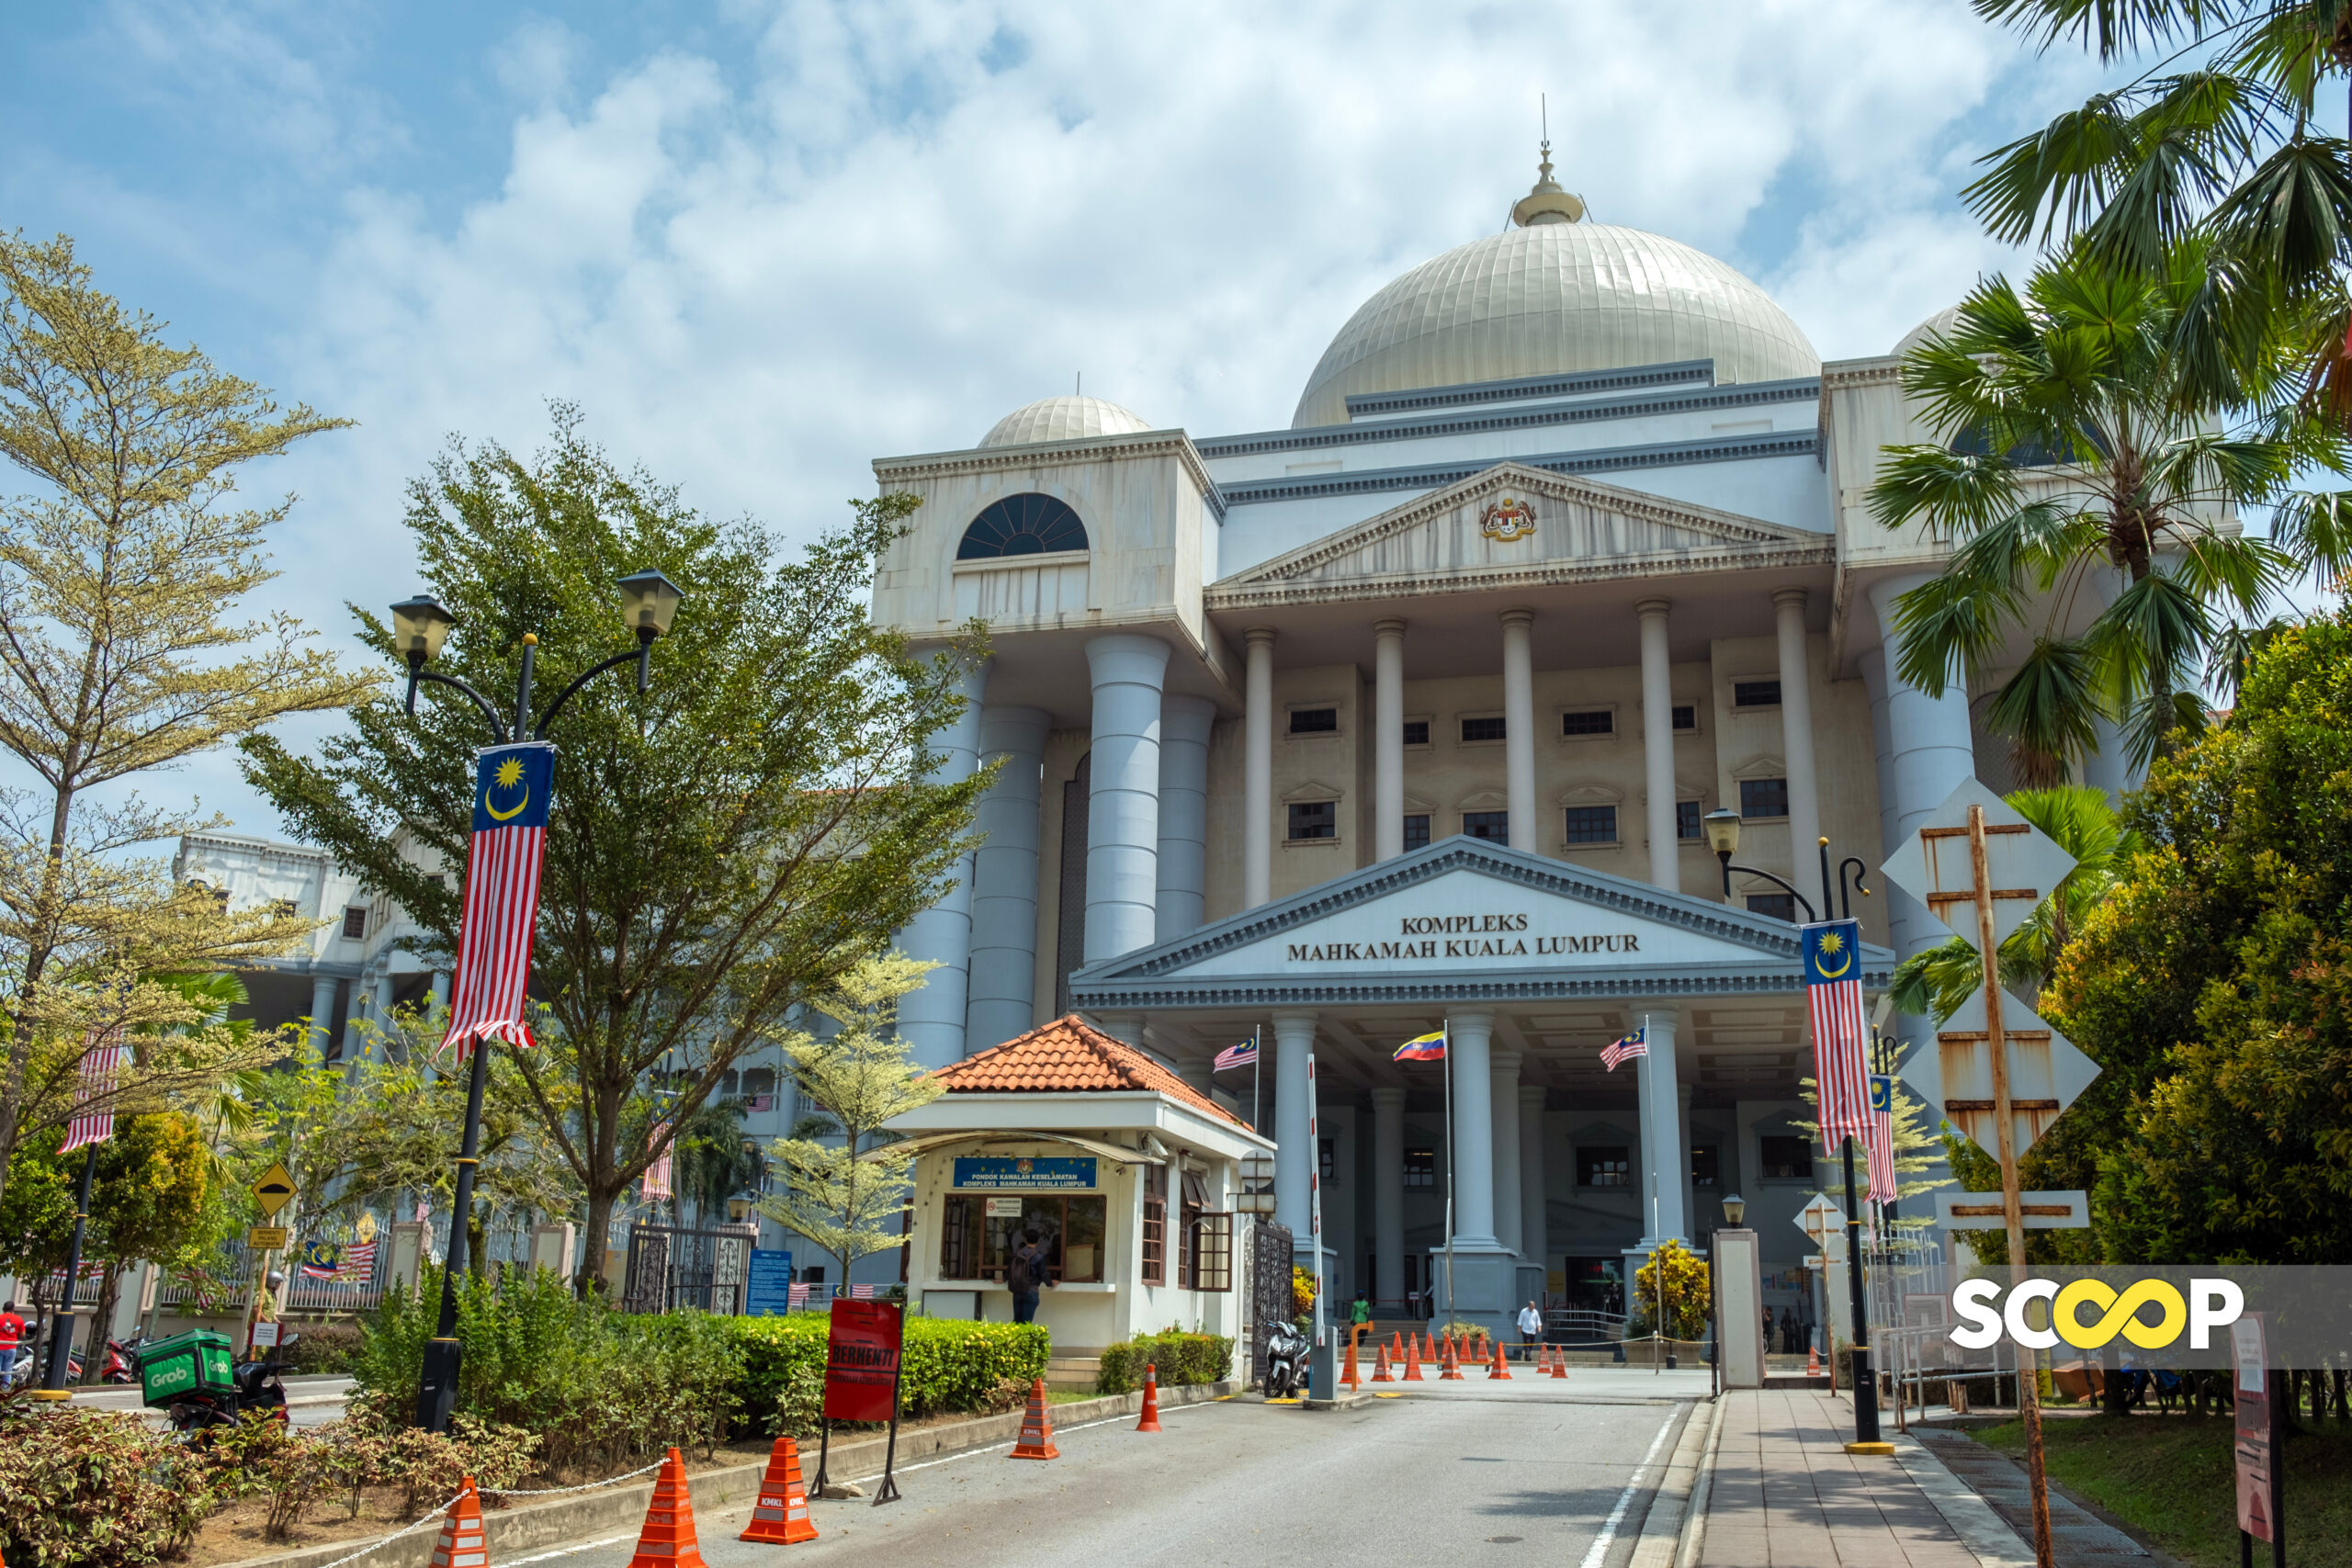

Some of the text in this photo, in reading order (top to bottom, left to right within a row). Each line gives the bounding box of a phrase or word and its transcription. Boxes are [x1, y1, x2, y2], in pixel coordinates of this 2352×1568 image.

[1400, 913, 1528, 936] KOMPLEKS
[1287, 933, 1641, 962] MAHKAMAH KUALA LUMPUR
[209, 1359, 229, 1374] Grab
[831, 1344, 895, 1368] BERHENTI
[151, 1366, 187, 1388] Grab
[761, 1497, 784, 1507] KMKL
[788, 1496, 805, 1507] KMKL
